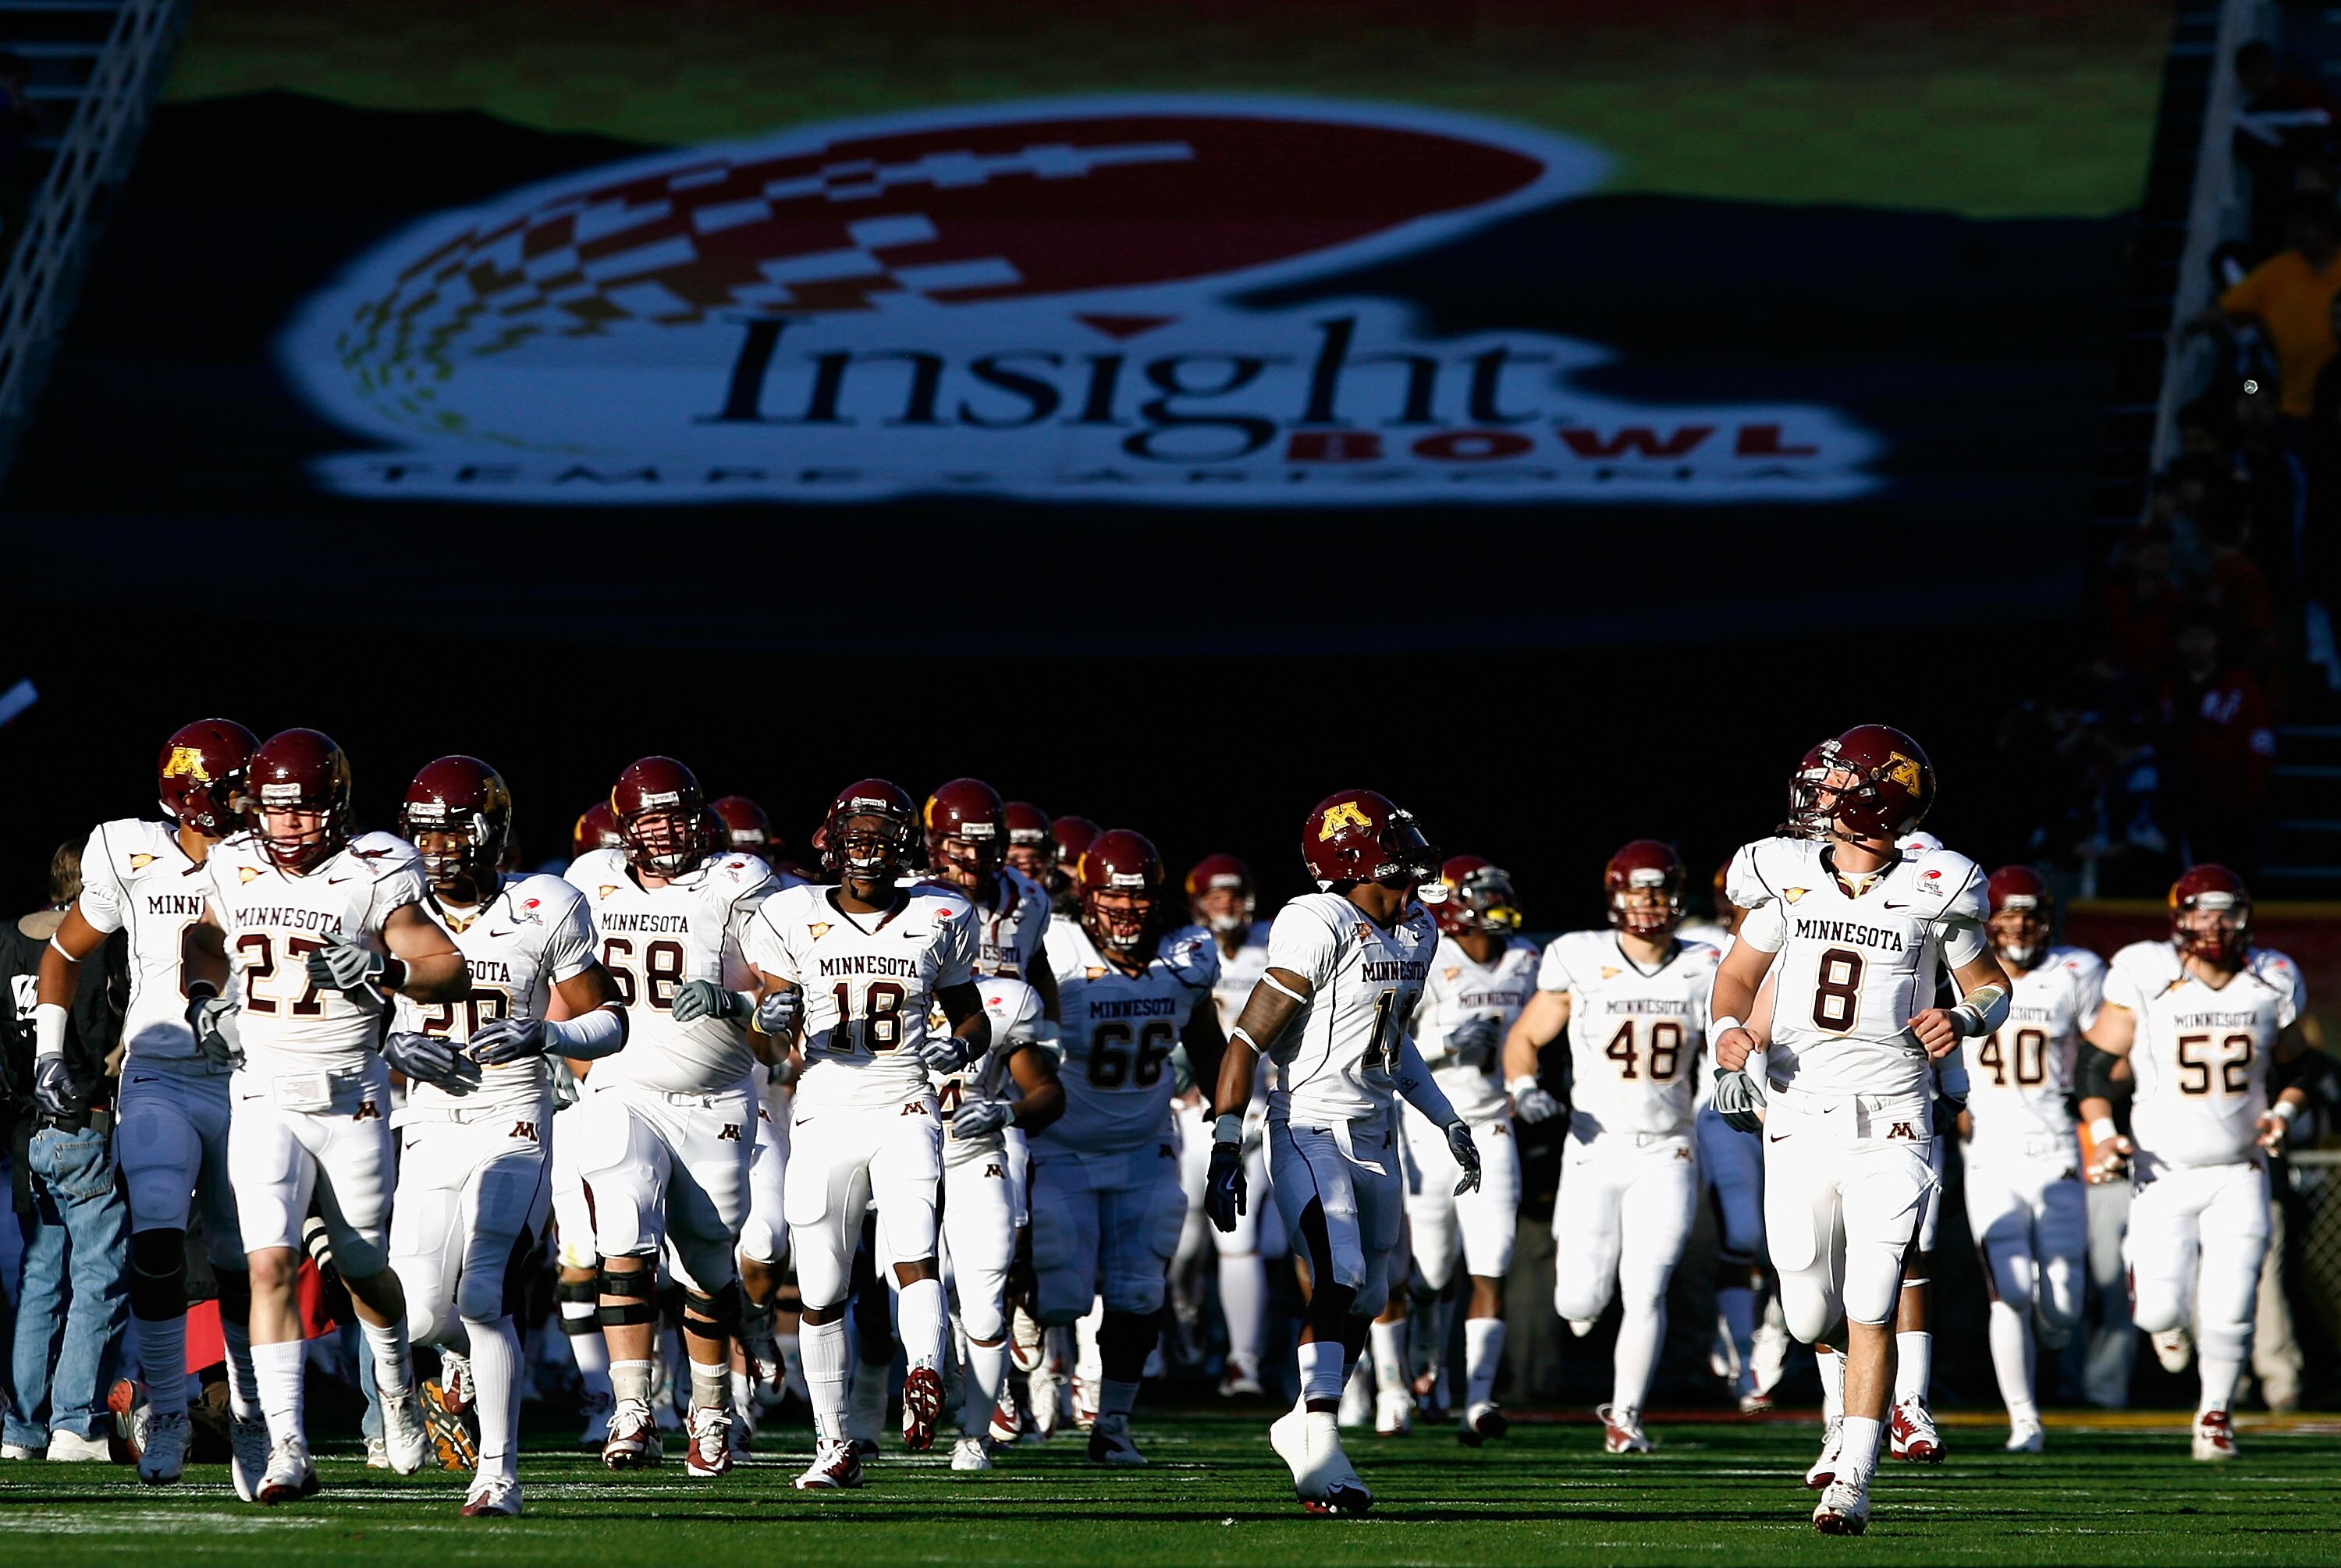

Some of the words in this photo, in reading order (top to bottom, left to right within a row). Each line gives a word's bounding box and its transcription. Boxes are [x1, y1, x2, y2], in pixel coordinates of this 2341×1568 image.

[690, 314, 1545, 462] Insight
[1285, 424, 1821, 462] BOWL
[147, 895, 205, 915] MINN
[235, 906, 343, 935] MINNESOTA
[601, 912, 688, 933] MINNESOTA
[1795, 918, 1902, 952] MINNESOTA
[235, 931, 332, 1019] 27
[602, 935, 687, 1012] 68
[819, 955, 919, 978] MINNESOTA
[1810, 944, 1868, 1037] 8
[827, 978, 909, 1055] 18
[1087, 1020, 1175, 1091] 66
[1604, 1019, 1685, 1082] 48
[1978, 1027, 2047, 1087] 40
[2176, 1034, 2254, 1096] 52
